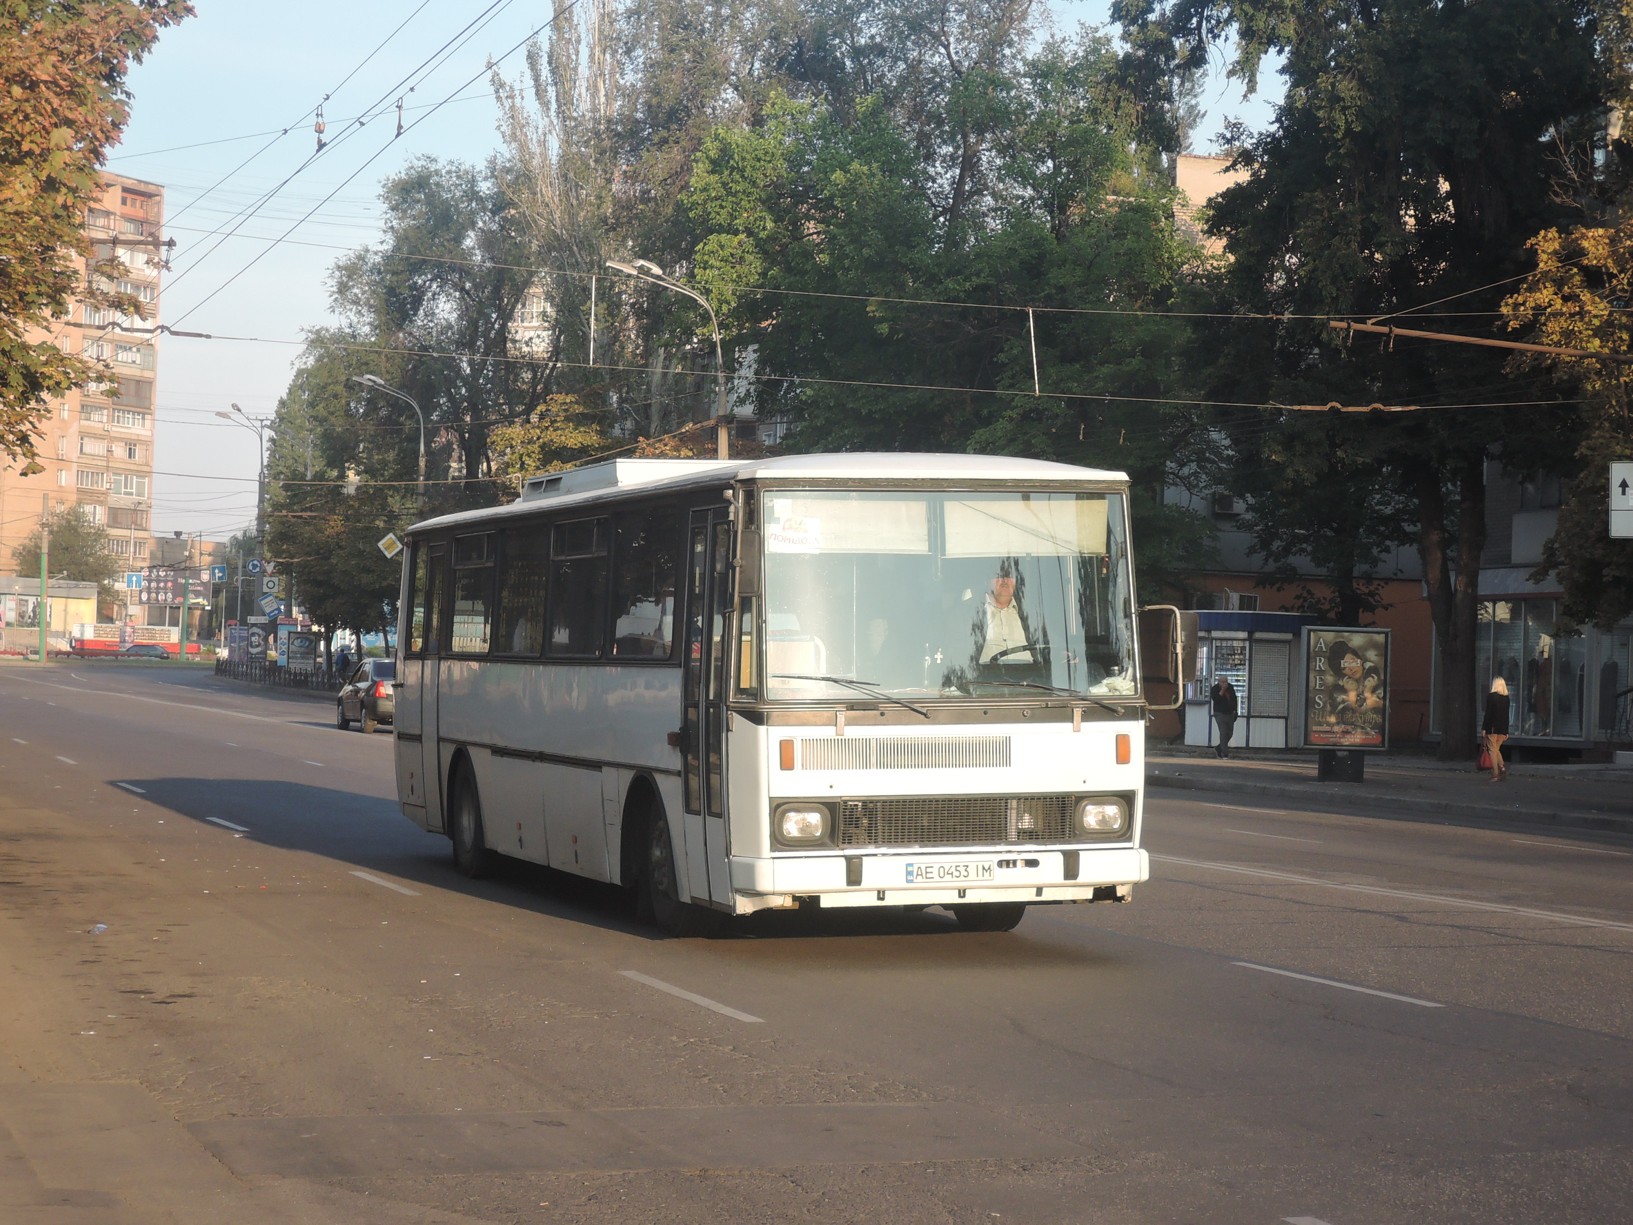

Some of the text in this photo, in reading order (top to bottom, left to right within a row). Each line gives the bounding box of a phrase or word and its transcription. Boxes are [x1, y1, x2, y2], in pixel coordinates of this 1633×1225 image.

[1315, 637, 1326, 709] ARES
[915, 866, 934, 880] AE
[938, 865, 970, 879] 0453
